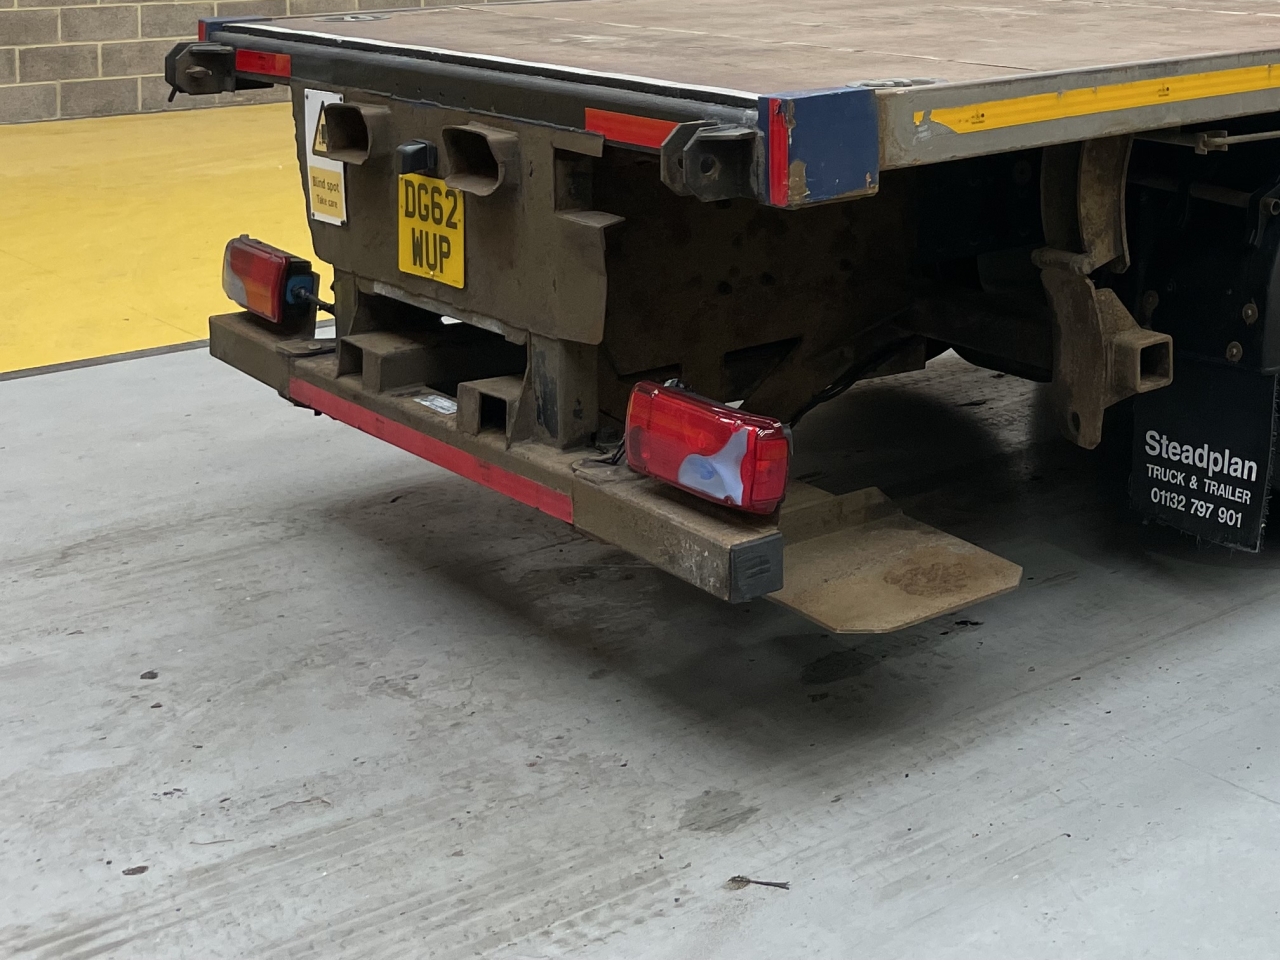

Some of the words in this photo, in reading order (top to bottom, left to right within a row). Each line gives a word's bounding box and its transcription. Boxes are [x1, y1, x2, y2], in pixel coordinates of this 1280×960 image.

[312, 175, 326, 190] Blind
[326, 181, 340, 193] spot
[316, 194, 328, 206] Take
[327, 199, 338, 209] care
[404, 178, 458, 230] DG62
[411, 227, 451, 274] WUP
[1144, 429, 1258, 482] Steadplan
[1146, 463, 1187, 487] TRUCK
[1189, 475, 1198, 490] &
[1203, 478, 1252, 505] TRAILER
[1150, 487, 1187, 512] 01132
[1190, 498, 1215, 519] 797
[1217, 506, 1243, 529] 901
